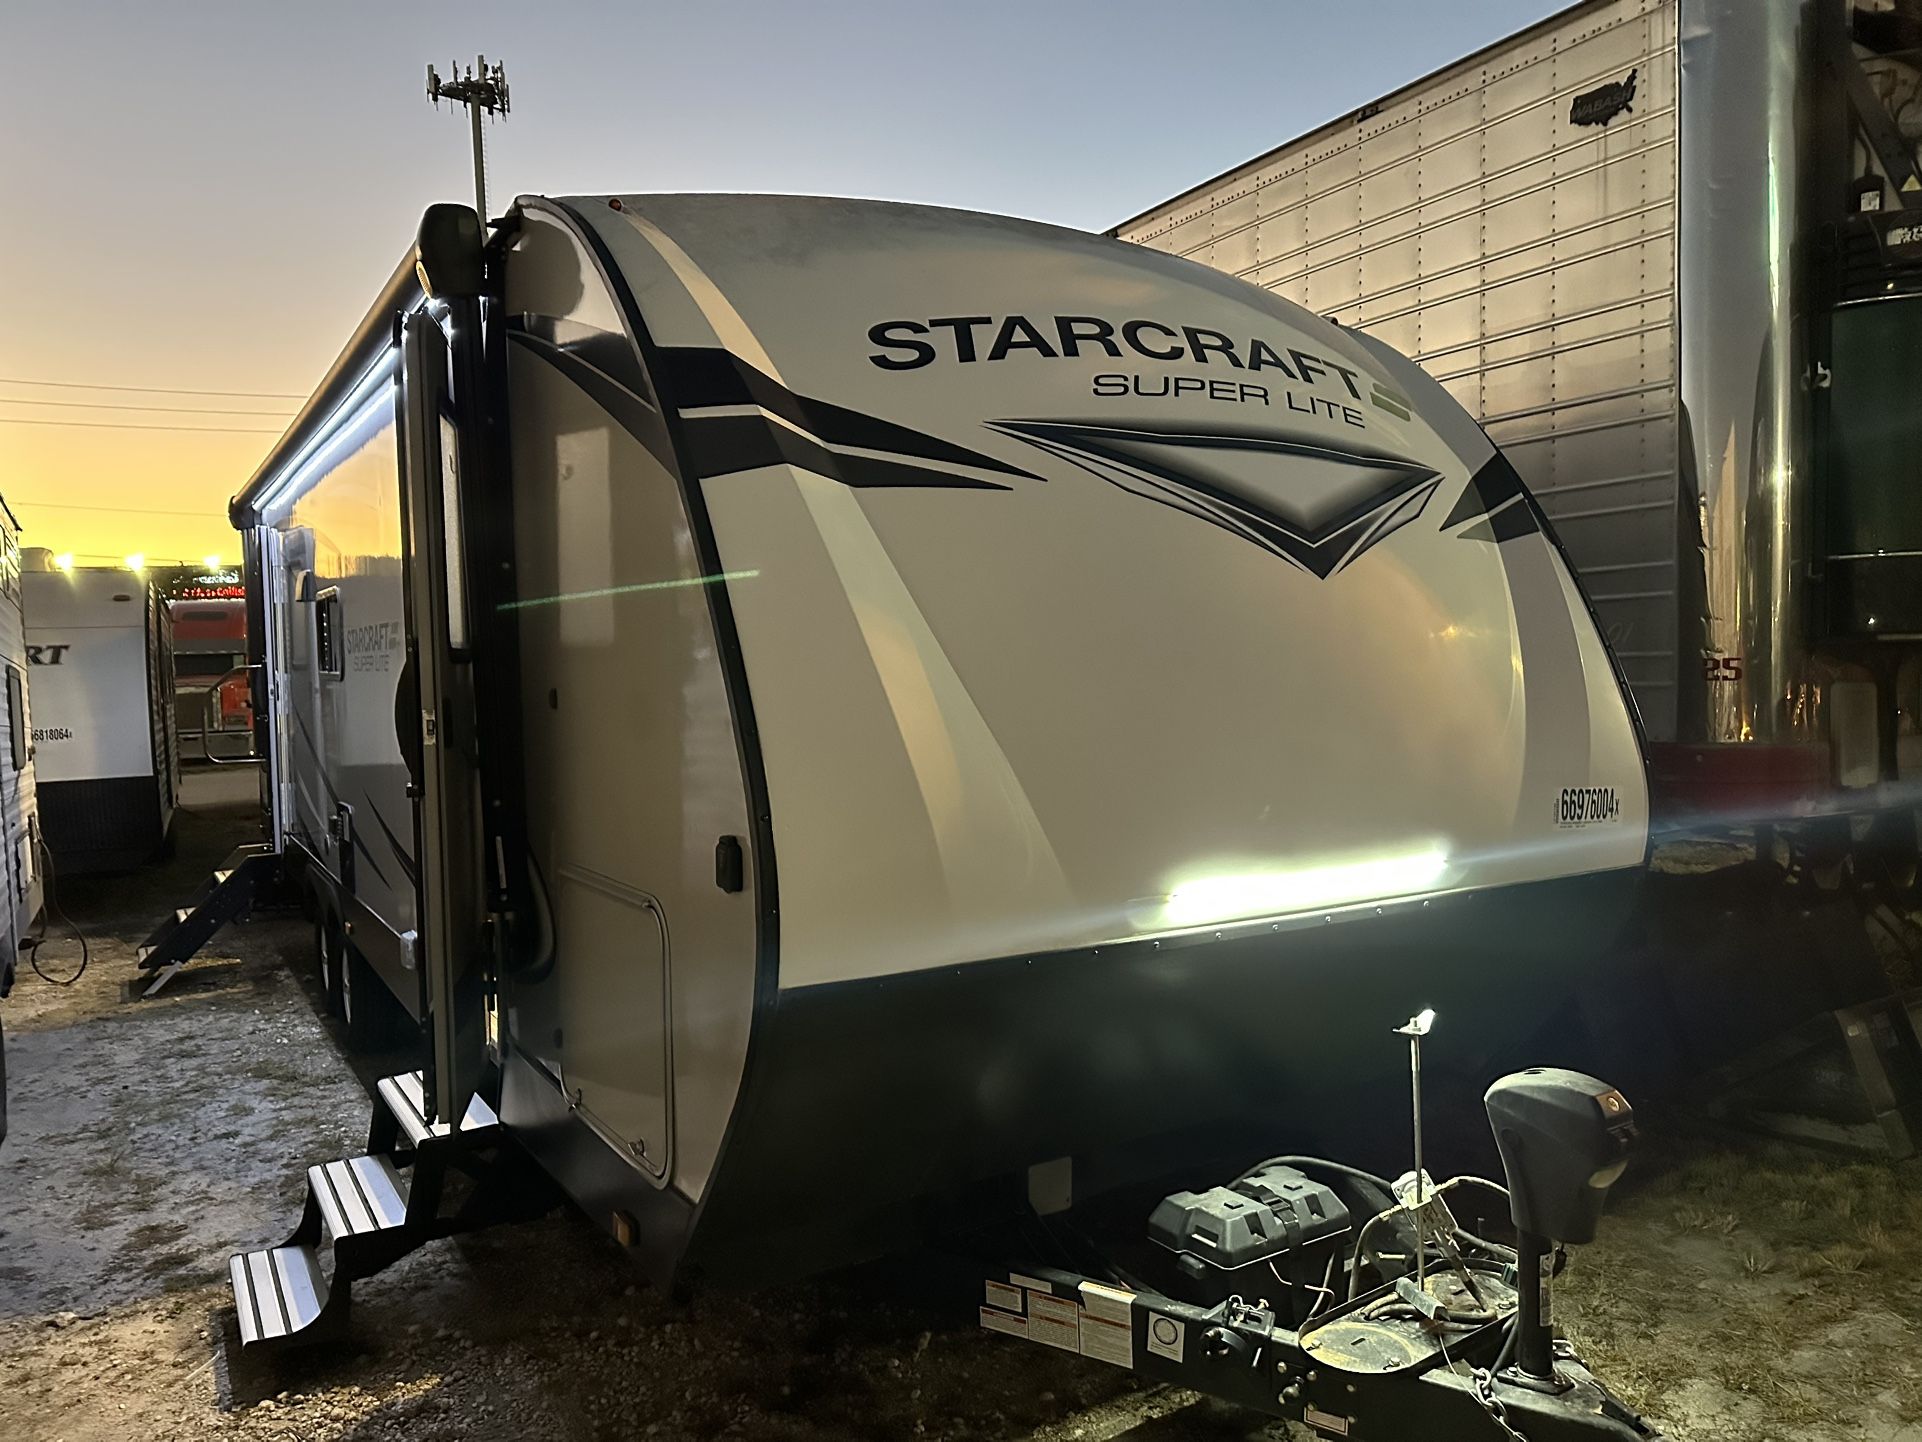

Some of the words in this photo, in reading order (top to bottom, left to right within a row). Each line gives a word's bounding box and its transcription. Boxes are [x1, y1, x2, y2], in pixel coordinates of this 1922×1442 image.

[1573, 84, 1633, 118] WABASH
[868, 315, 1361, 401] STARCRAFT
[1092, 374, 1269, 406] SUPER
[1287, 391, 1366, 429] LITE
[347, 622, 389, 654] STARCRAFT
[354, 655, 374, 672] SUPER
[375, 654, 389, 672] LITE
[1703, 657, 1742, 681] 25
